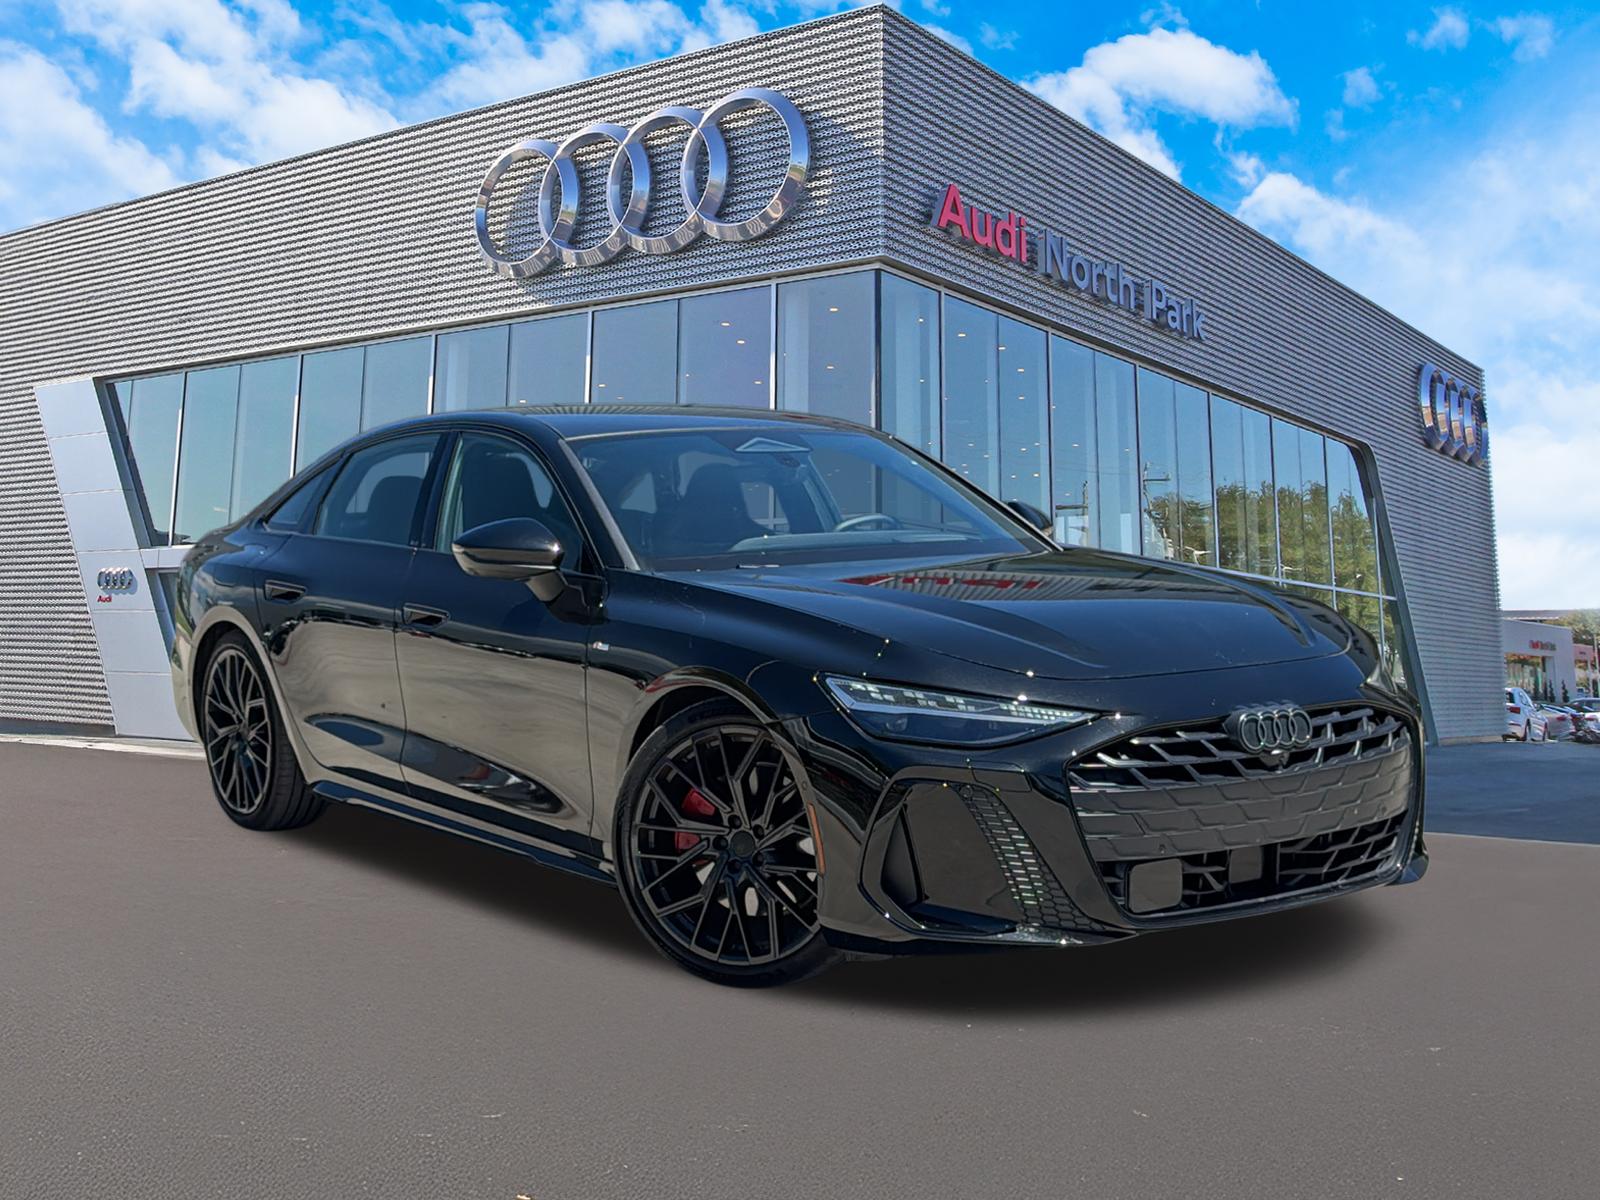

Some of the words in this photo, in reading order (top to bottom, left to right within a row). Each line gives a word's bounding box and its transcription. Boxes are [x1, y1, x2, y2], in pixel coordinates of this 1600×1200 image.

[936, 182, 1028, 264] Audi
[1043, 229, 1137, 311] North
[1148, 279, 1206, 341] Park
